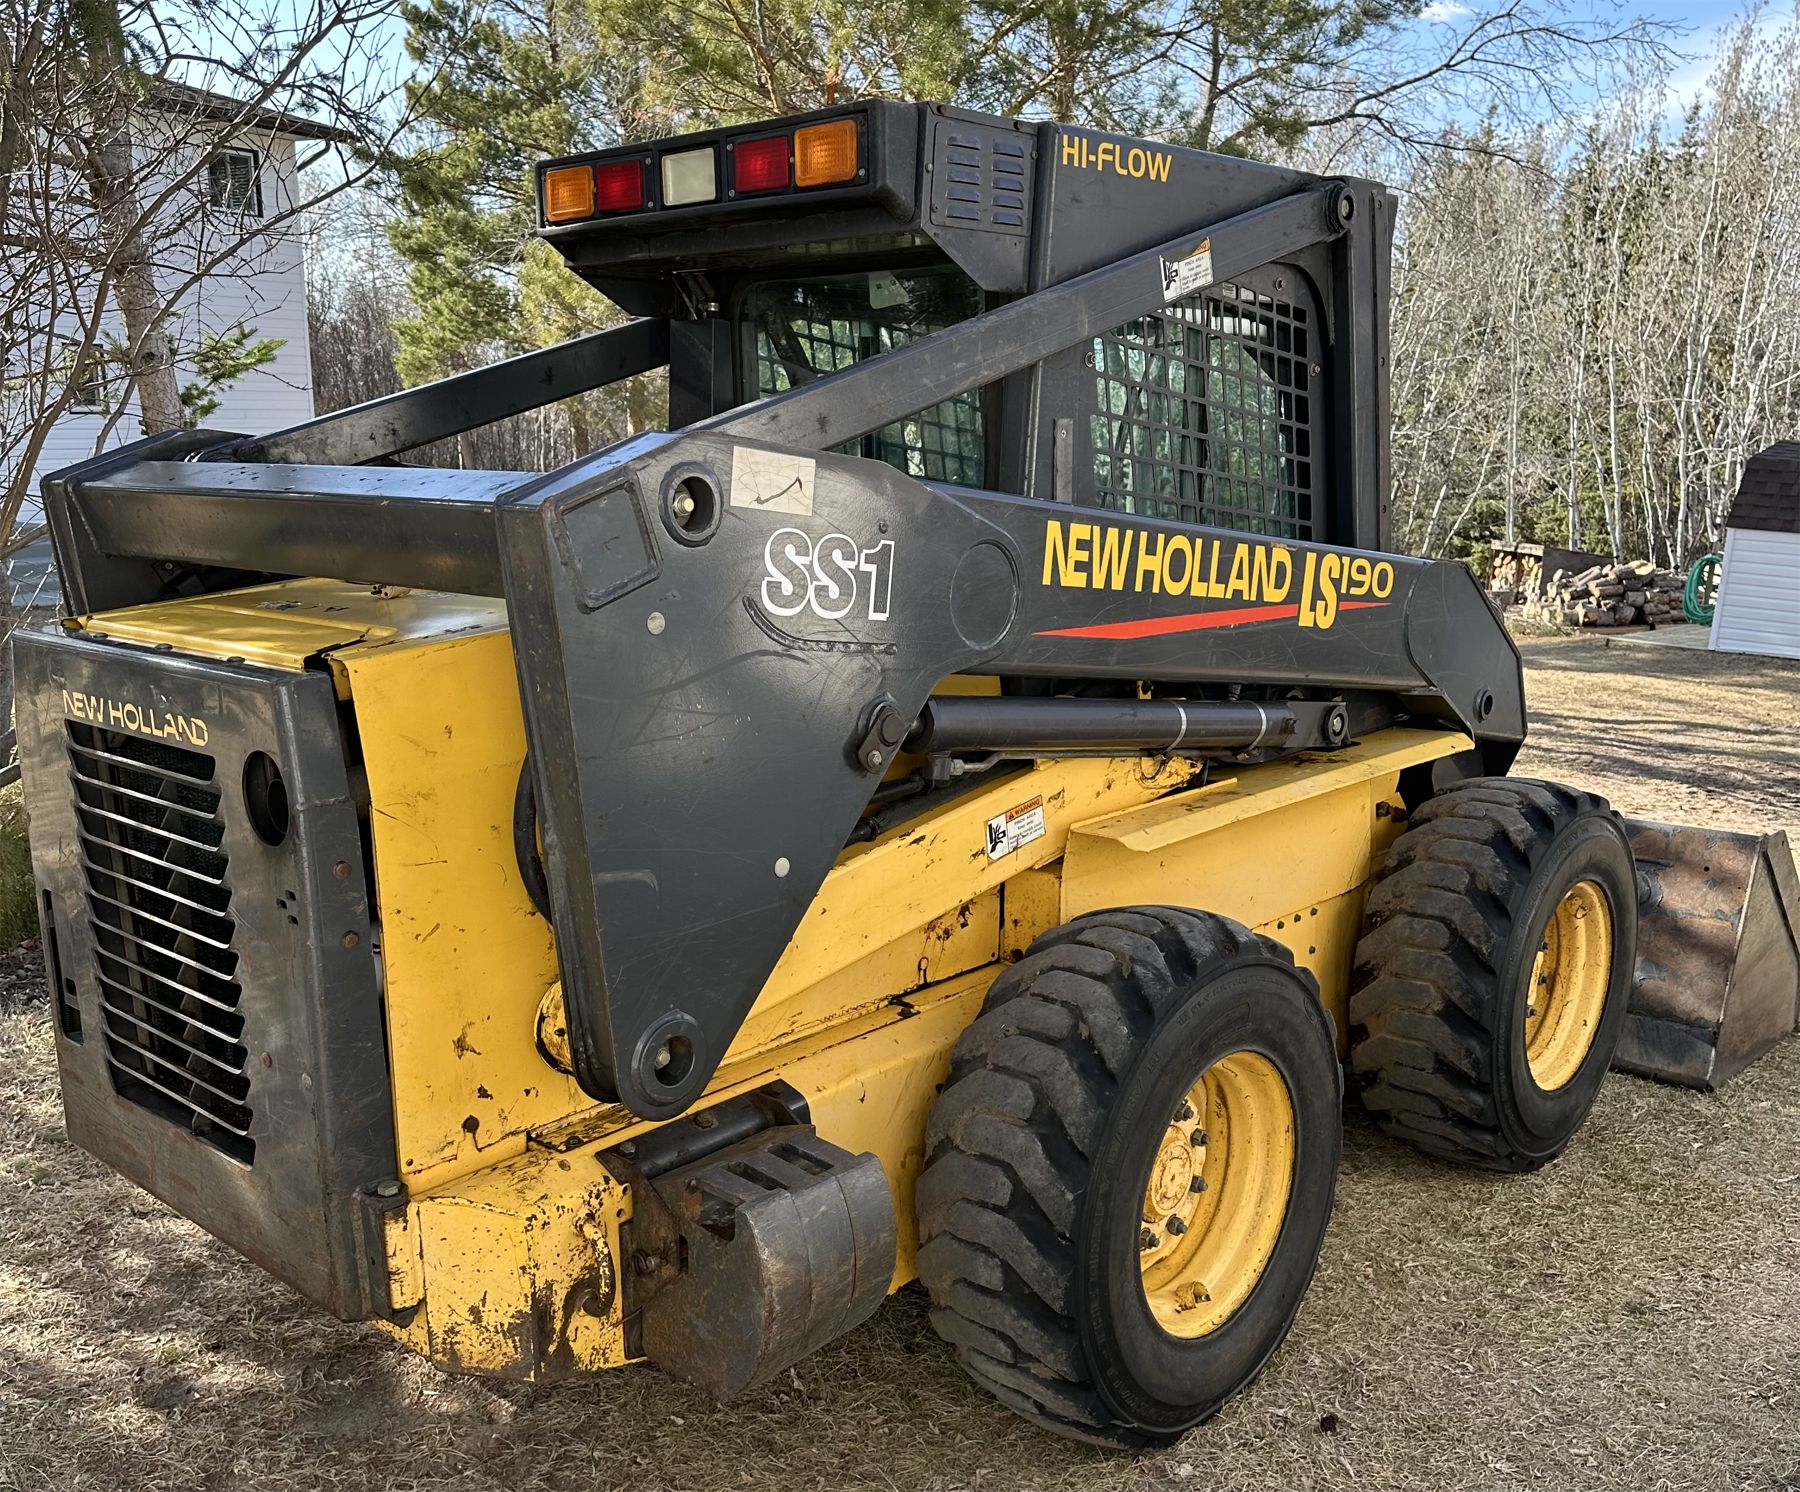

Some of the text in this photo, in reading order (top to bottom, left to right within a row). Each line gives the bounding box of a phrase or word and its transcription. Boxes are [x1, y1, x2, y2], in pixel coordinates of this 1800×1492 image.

[1062, 134, 1173, 182] HI-FLOW
[761, 527, 895, 621] SS1
[1042, 520, 1133, 591] NEW
[1134, 530, 1292, 603] HOLLAND
[62, 689, 209, 747] NEW HOLLAND
[1014, 798, 1040, 816] WARNING
